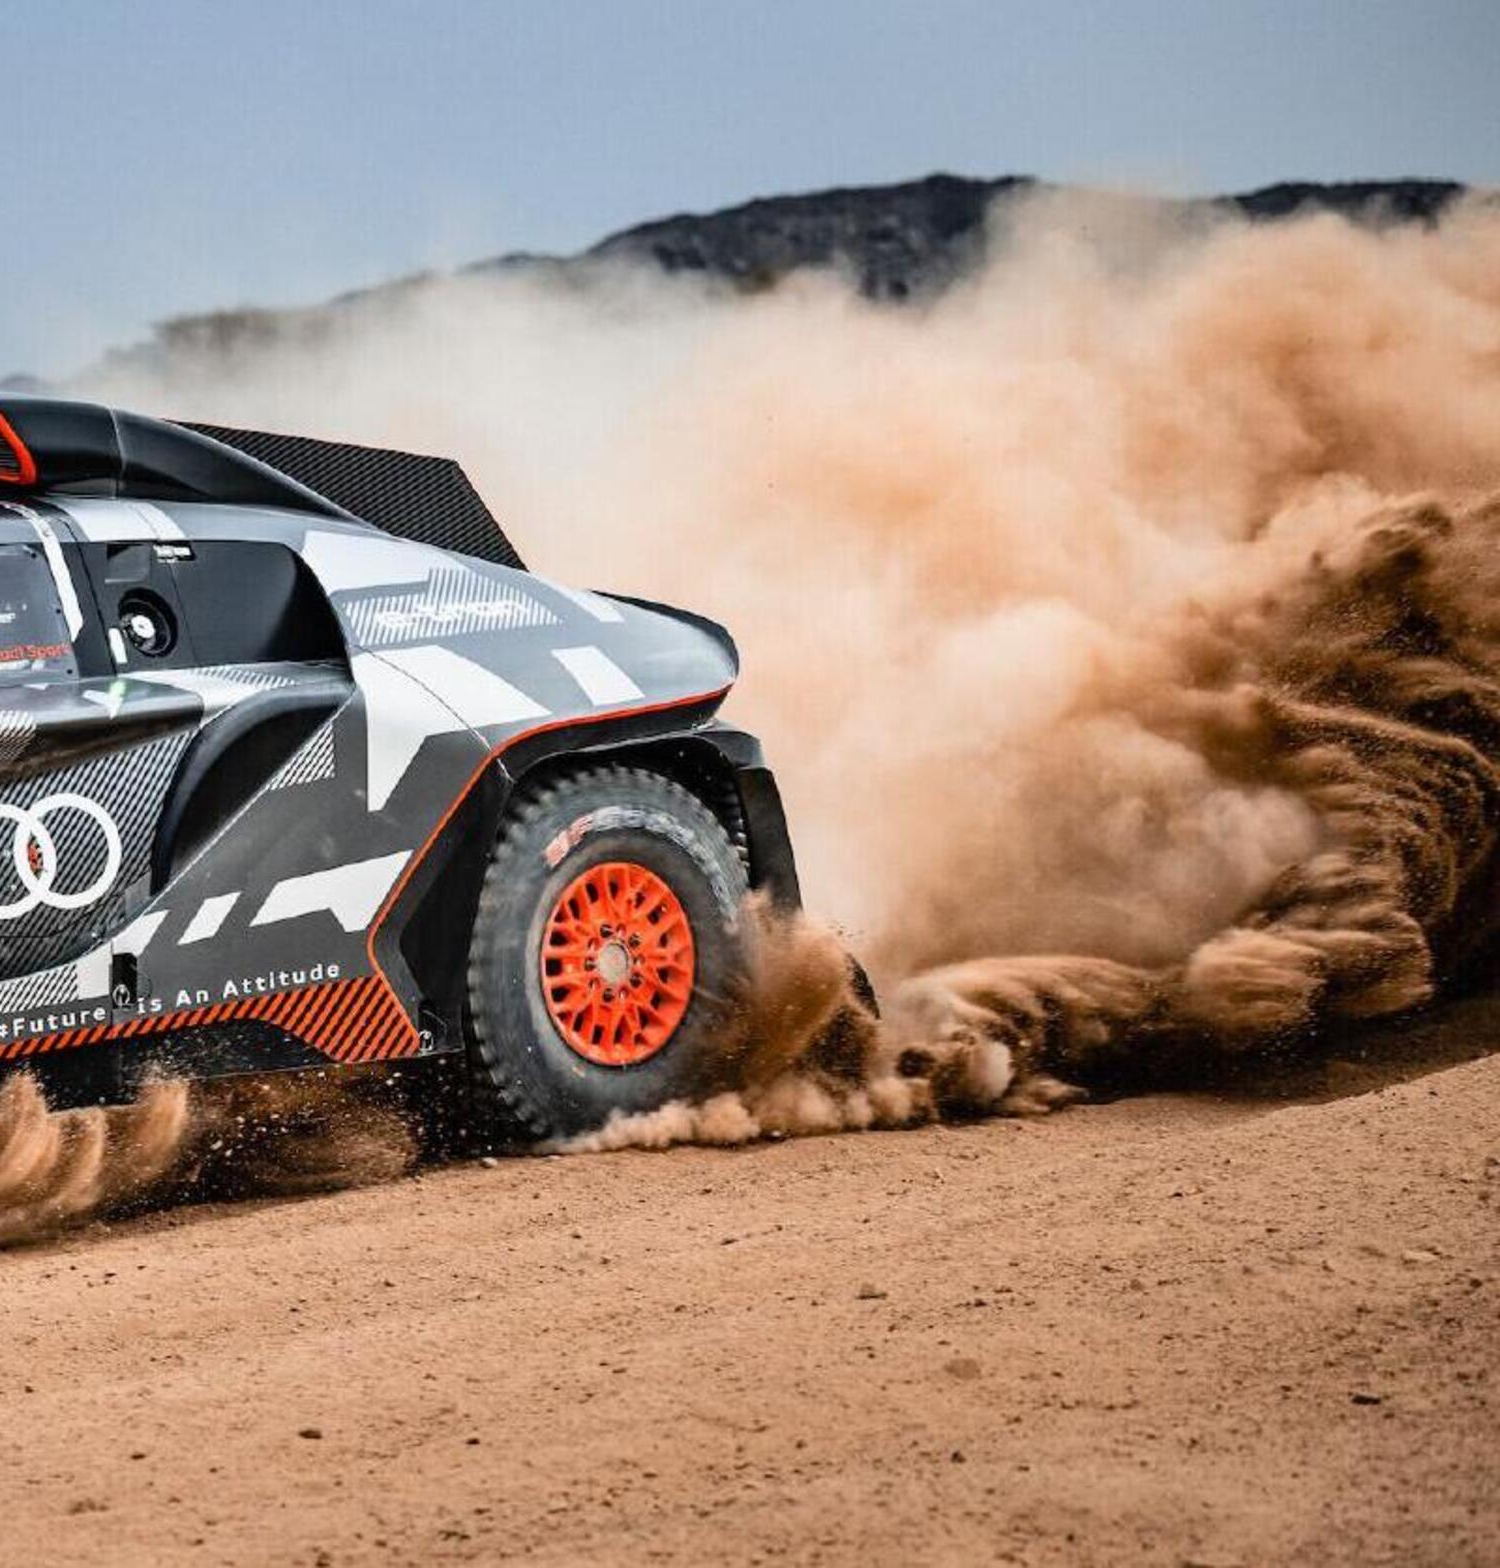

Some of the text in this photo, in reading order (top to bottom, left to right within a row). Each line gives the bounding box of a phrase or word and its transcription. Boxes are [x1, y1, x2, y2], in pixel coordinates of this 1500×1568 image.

[137, 995, 162, 1014] is
[176, 988, 209, 1007] An
[222, 961, 340, 998] Attitude
